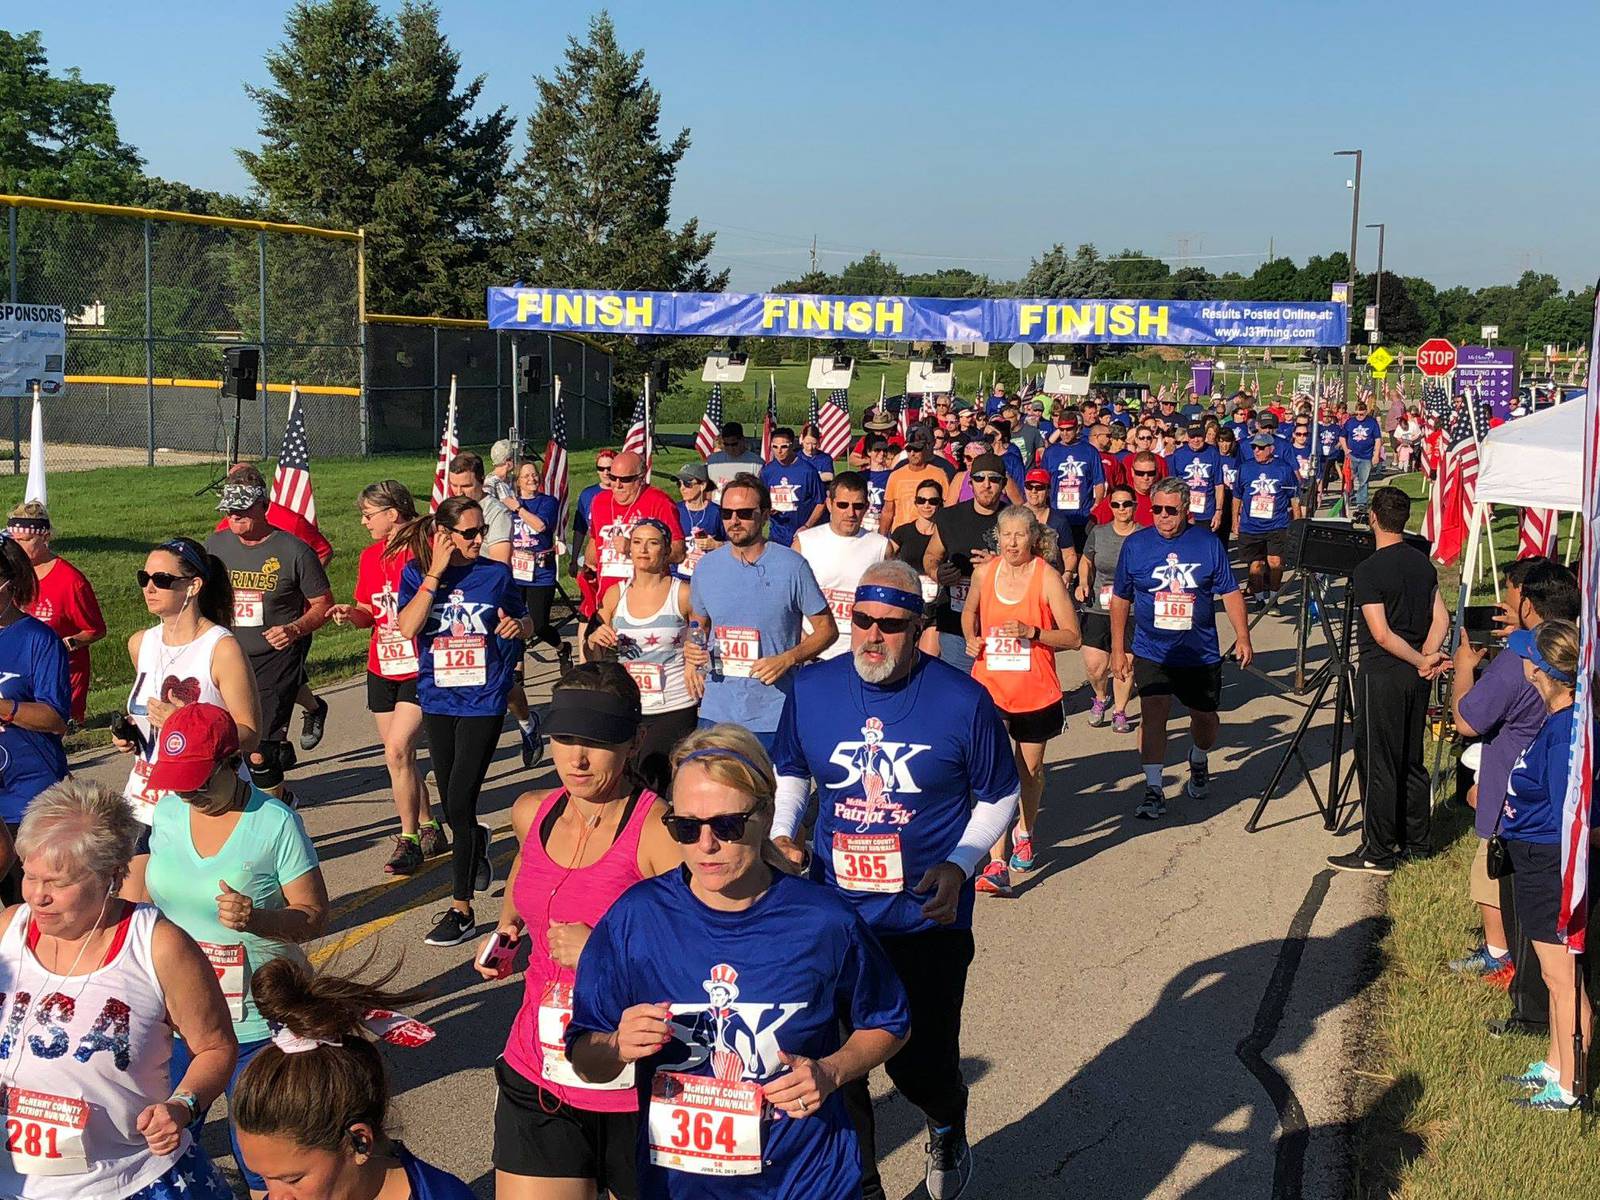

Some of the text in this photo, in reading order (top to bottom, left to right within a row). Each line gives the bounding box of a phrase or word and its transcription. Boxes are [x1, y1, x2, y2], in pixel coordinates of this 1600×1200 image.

[0, 305, 62, 323] SPONSORS
[516, 293, 653, 327] FINISH
[762, 299, 904, 333] FINISH
[1202, 308, 1334, 320] Results Posted Online at:
[1019, 304, 1169, 337] FINISH
[1215, 326, 1316, 339] www.J3Timing.com
[1420, 350, 1454, 366] STOP
[230, 570, 278, 591] RINES
[1148, 563, 1201, 592] 5K
[1163, 603, 1186, 616] 166
[381, 643, 406, 659] 262
[723, 640, 749, 658] 340
[994, 639, 1022, 654] 250
[445, 649, 475, 667] 126
[825, 741, 932, 793] 5K
[834, 803, 886, 824] Patriot
[844, 854, 888, 878] 365
[684, 1082, 755, 1100] McHENRY COUNTY
[19, 1096, 83, 1115] McHENRY COUNTY
[683, 1093, 755, 1111] PATRIOT RUN/WALK
[16, 1105, 44, 1118] PATRIOT
[5, 1118, 63, 1159] 281
[670, 1109, 736, 1154] 364
